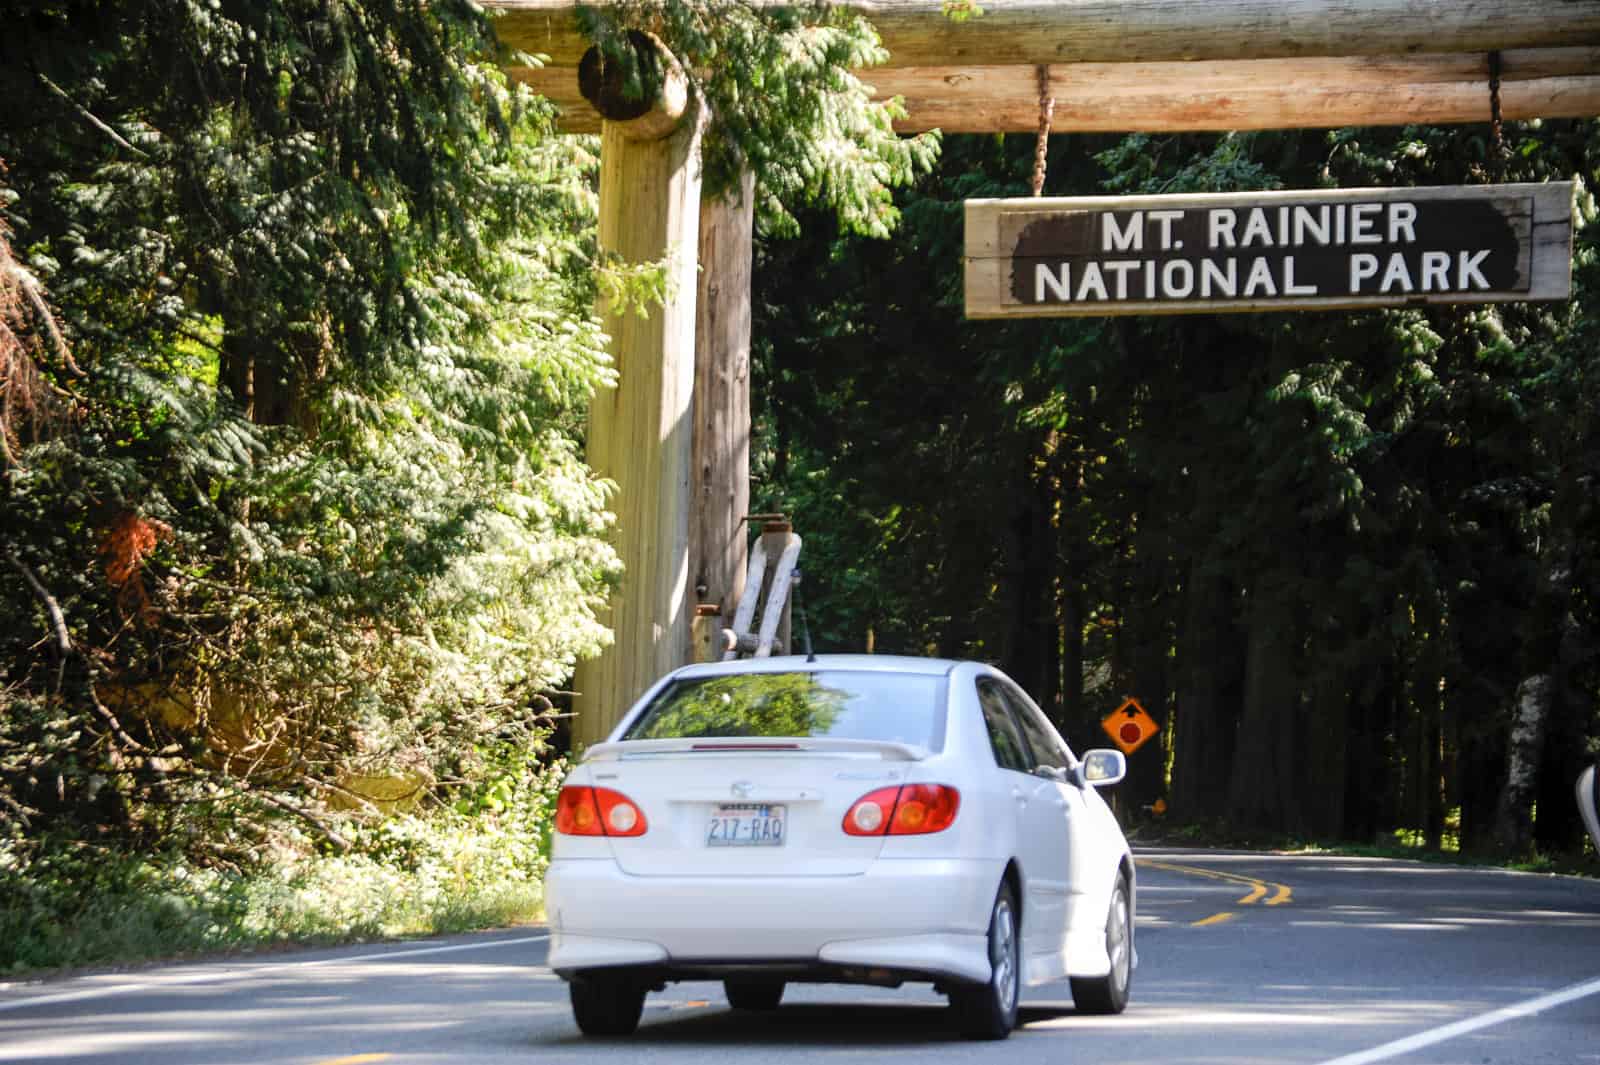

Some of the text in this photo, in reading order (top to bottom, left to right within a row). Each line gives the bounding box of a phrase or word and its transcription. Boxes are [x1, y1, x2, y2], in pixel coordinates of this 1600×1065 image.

[1102, 203, 1417, 251] MT. RAINIER
[1035, 249, 1491, 302] NATIONAL PARK
